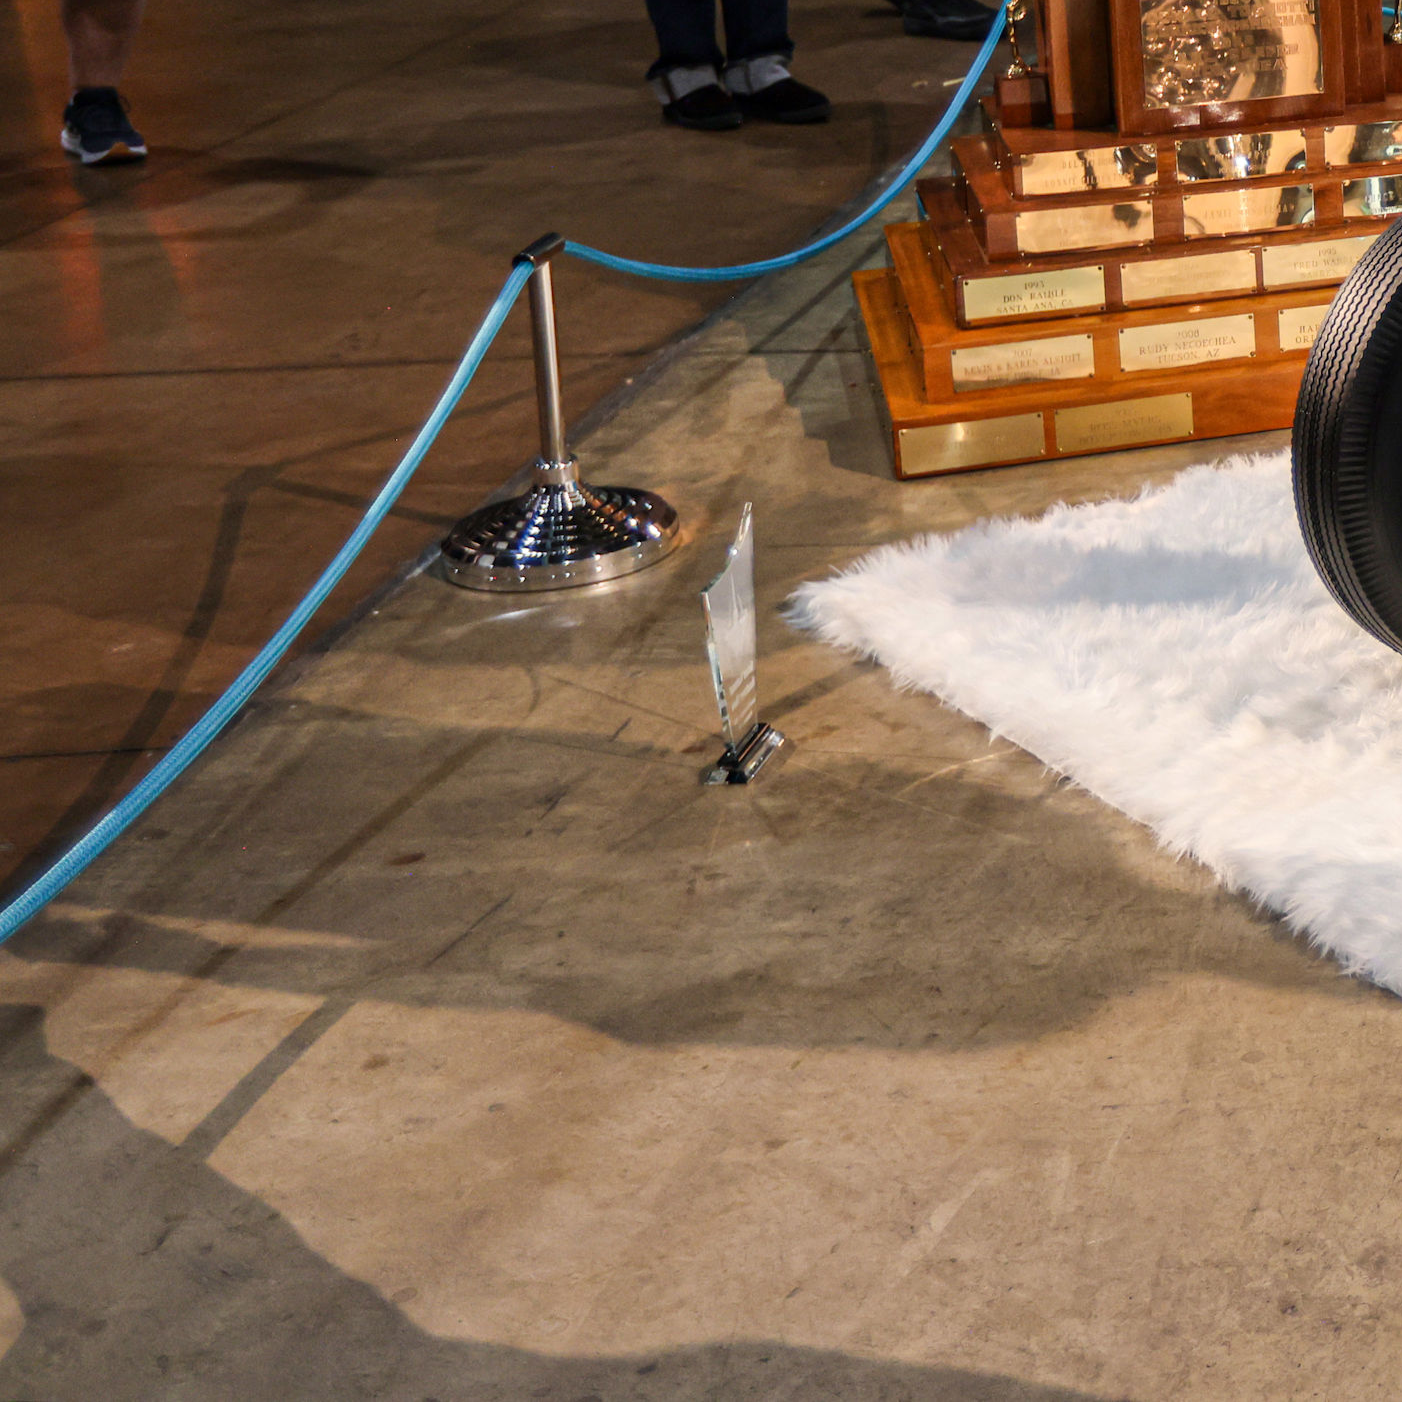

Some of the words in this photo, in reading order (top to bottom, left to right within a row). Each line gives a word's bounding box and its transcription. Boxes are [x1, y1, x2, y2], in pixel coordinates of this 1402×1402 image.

[1002, 293, 1023, 302] DON
[996, 304, 1027, 313] SANTA
[1139, 343, 1169, 354] RUDY
[1206, 349, 1220, 357] AZ
